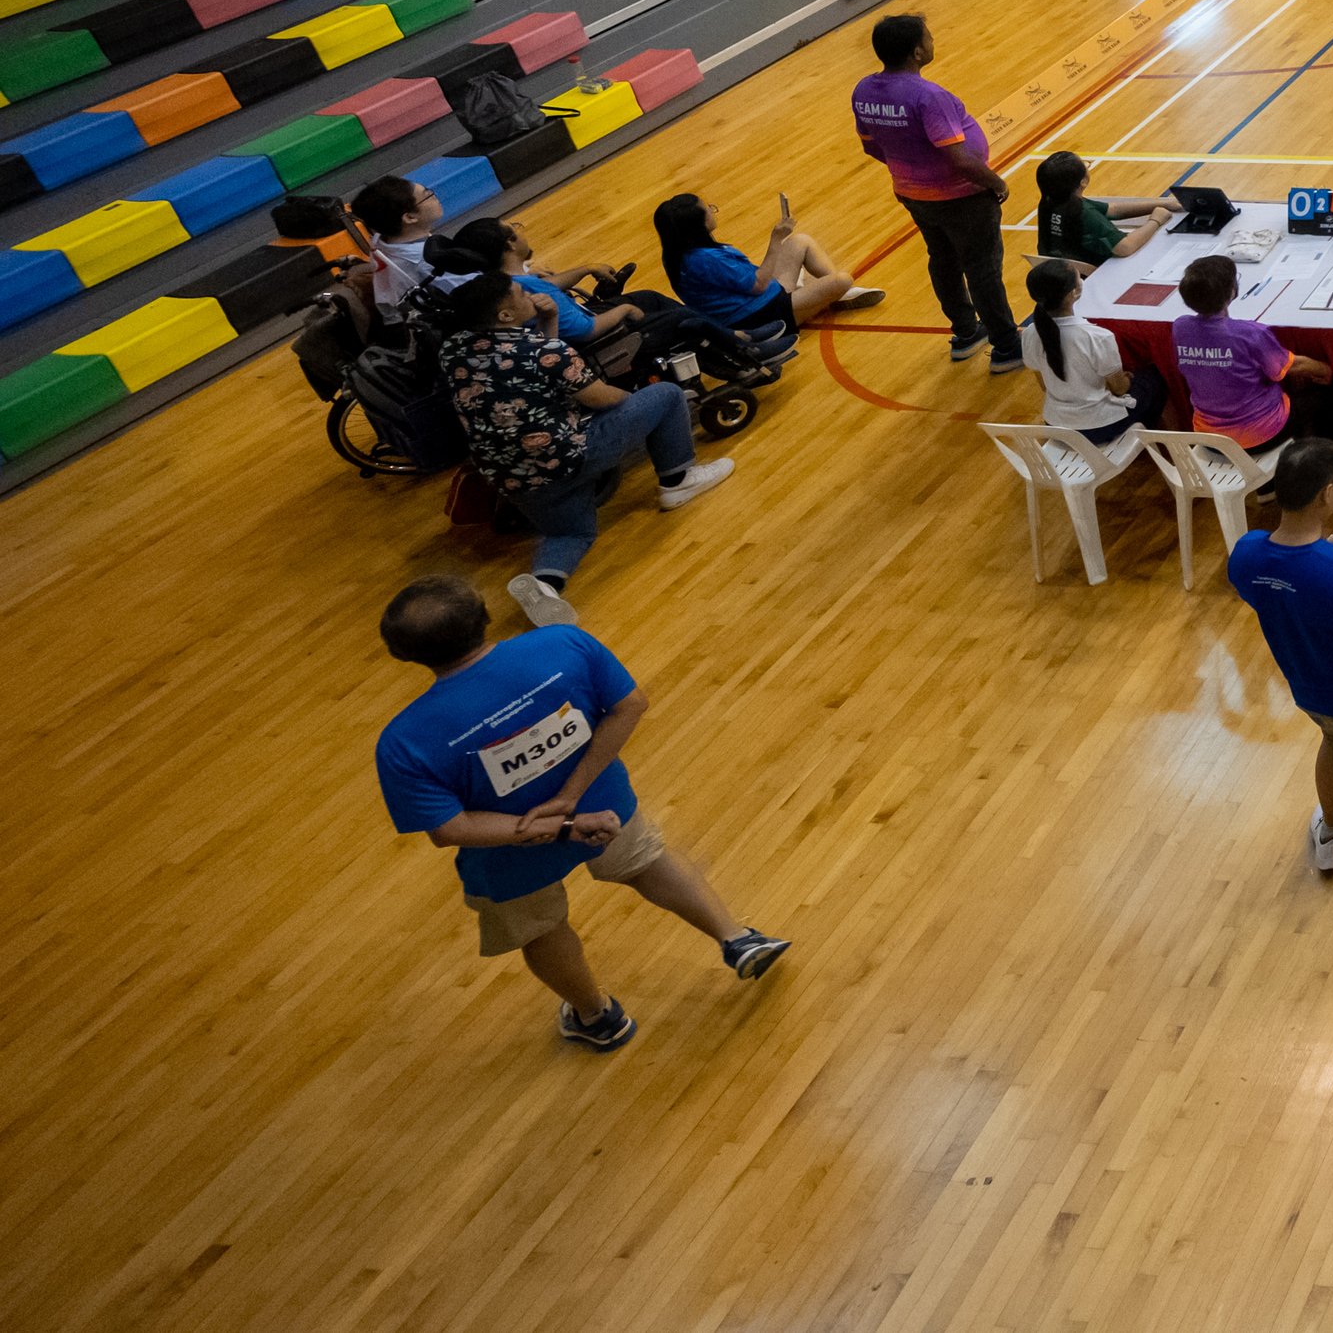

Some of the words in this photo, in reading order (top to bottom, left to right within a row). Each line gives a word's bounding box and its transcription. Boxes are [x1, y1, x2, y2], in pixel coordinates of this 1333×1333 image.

[881, 104, 907, 117] NILA
[1291, 191, 1311, 217] 0
[1316, 197, 1326, 211] 2
[1177, 345, 1203, 358] TEAM
[1205, 346, 1233, 359] NILA
[501, 720, 578, 775] M306
